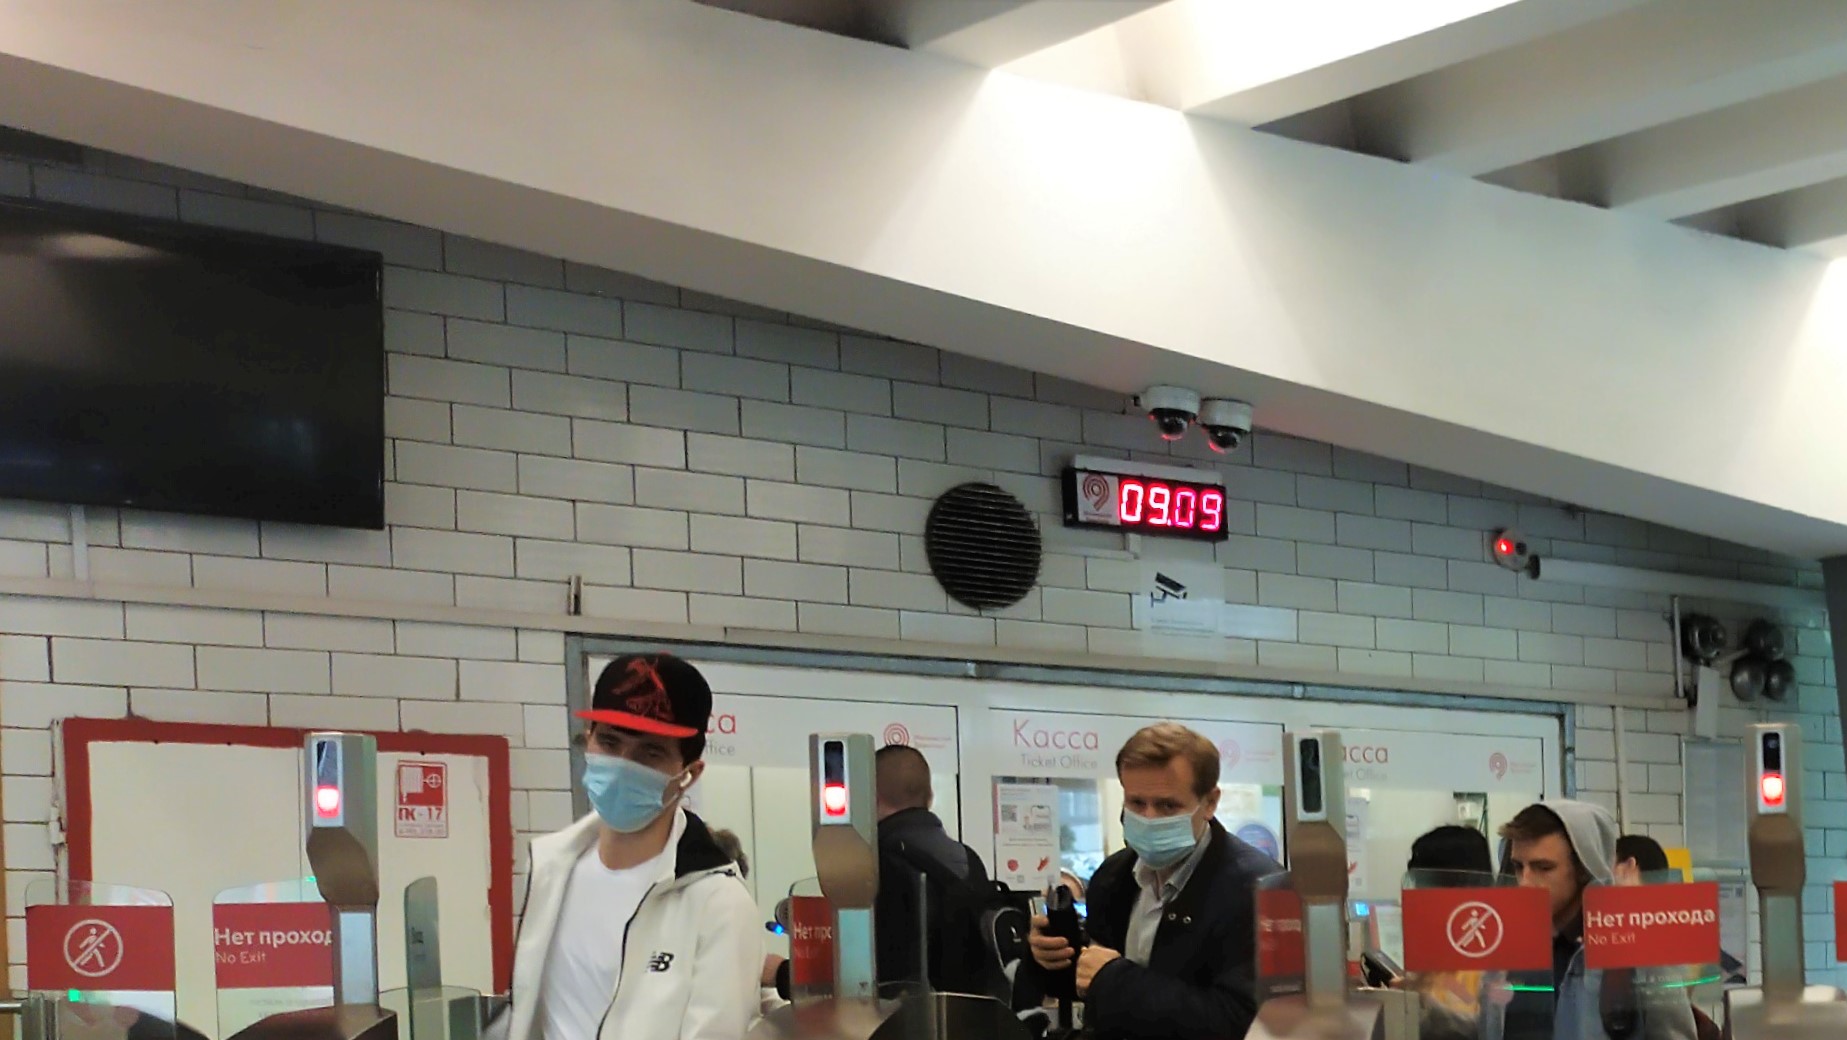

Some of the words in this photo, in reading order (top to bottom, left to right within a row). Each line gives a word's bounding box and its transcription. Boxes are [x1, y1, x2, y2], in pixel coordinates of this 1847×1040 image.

[1013, 719, 1098, 751] Касса
[1021, 753, 1056, 768] Ticket
[1060, 755, 1098, 769] Office
[1586, 910, 1625, 928] Нет
[1629, 909, 1716, 929] прохода
[214, 928, 255, 946] Нет
[1588, 934, 1607, 945] No
[1611, 932, 1636, 945] Exit
[215, 951, 236, 964] No
[240, 951, 267, 964] Exit
